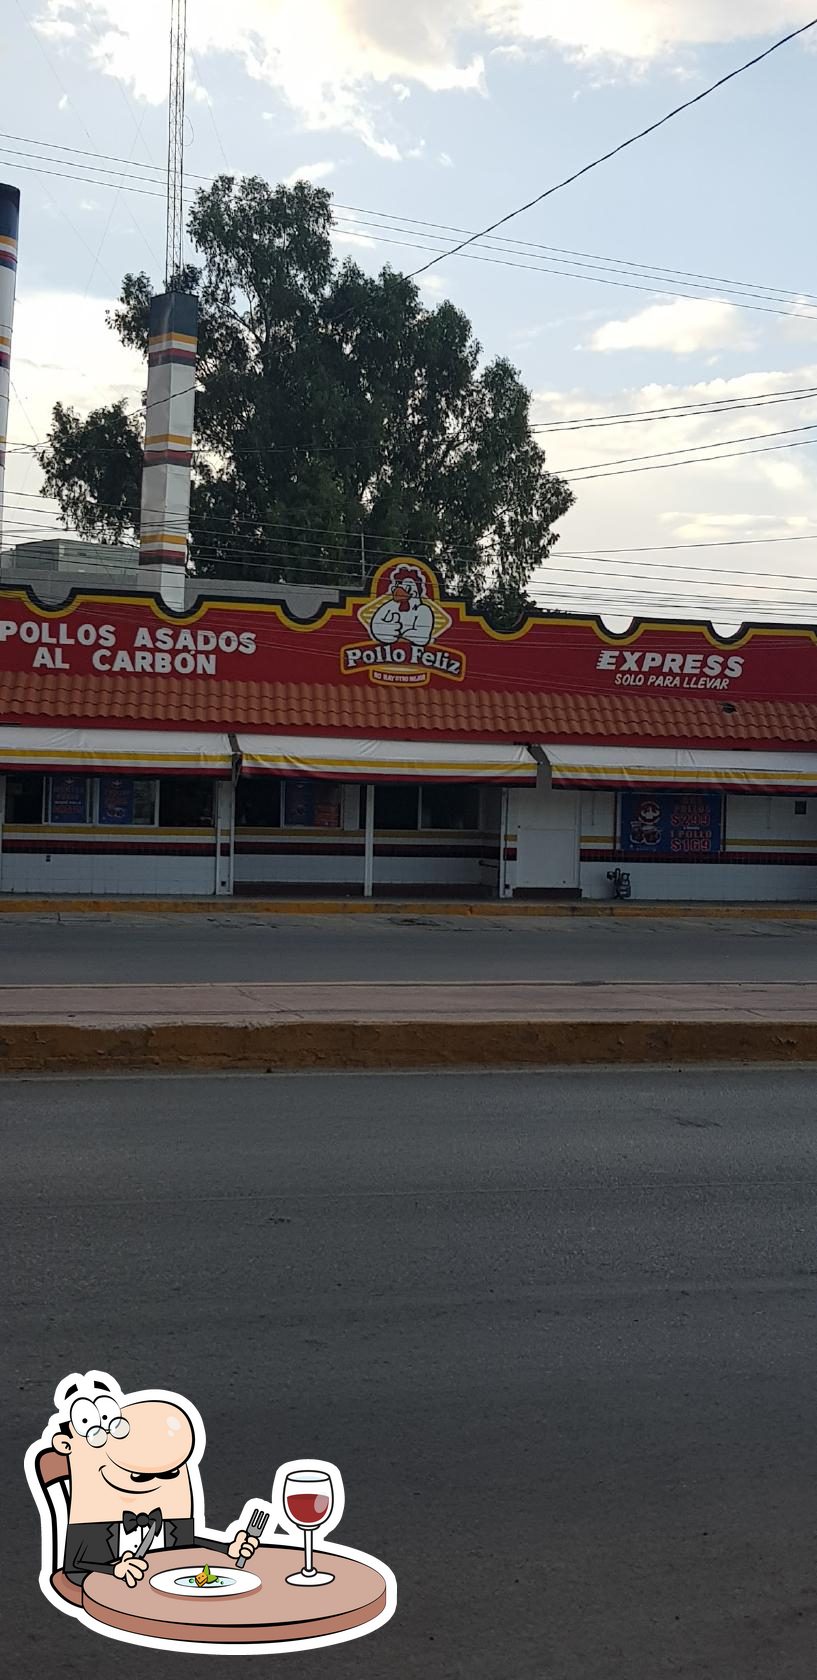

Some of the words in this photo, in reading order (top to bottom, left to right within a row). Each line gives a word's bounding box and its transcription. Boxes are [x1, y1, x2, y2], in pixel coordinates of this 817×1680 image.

[0, 620, 117, 647] POLLOS
[134, 627, 257, 654] ASADOS
[32, 646, 70, 670] AL
[92, 649, 217, 675] CARBÓN
[346, 645, 405, 667] Pollo
[410, 645, 461, 675] Feliz
[596, 650, 745, 678] EXPRESS
[614, 673, 645, 686] SOLO
[647, 675, 680, 688] PARA
[682, 676, 730, 690] LLEVAR
[670, 838, 712, 852] $169
